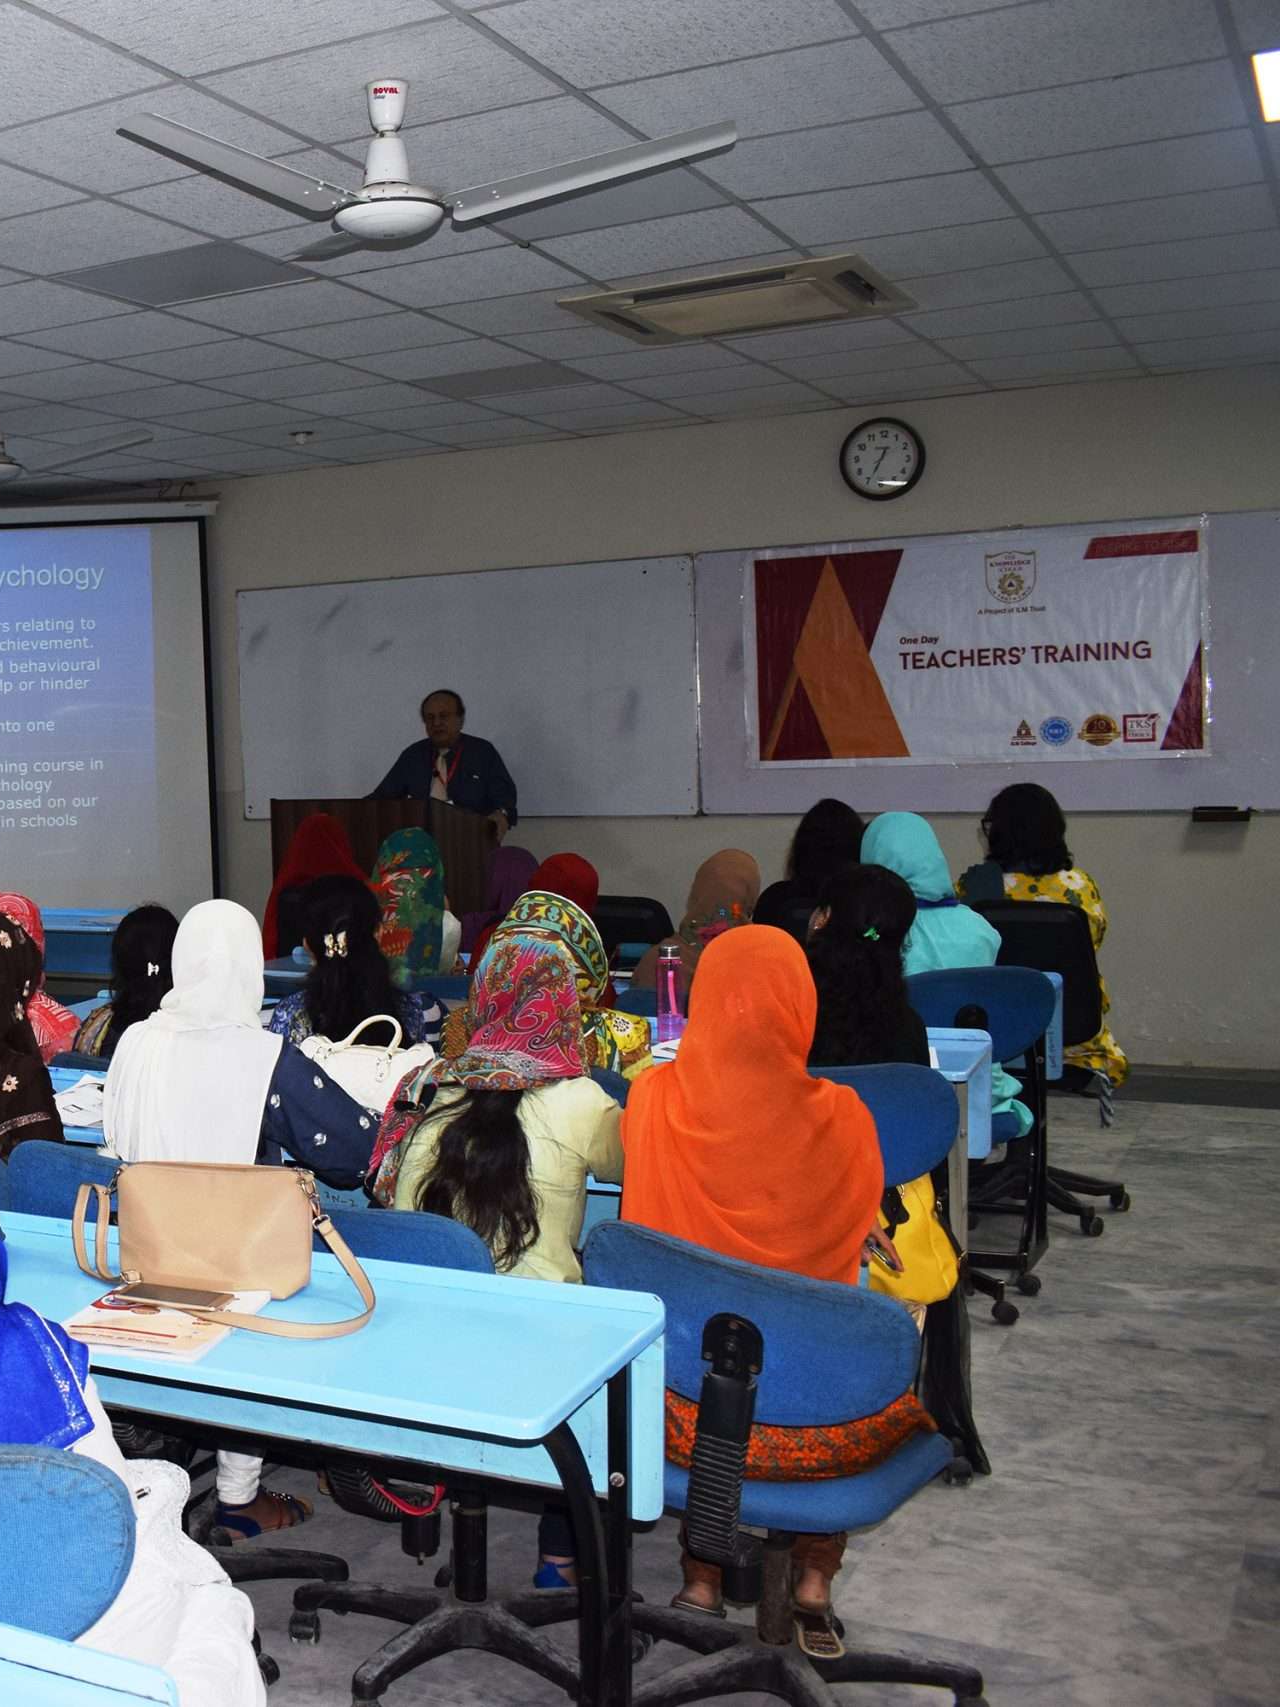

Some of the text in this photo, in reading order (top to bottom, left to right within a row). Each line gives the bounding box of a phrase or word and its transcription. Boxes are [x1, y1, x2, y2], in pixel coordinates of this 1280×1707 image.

[15, 617, 74, 633] relating
[80, 616, 96, 630] to
[899, 635, 939, 645] One Day
[899, 640, 1152, 670] TEACHERS' TRAINING
[8, 655, 100, 673] behavioural
[18, 680, 35, 691] or
[40, 675, 89, 690] hinder
[25, 719, 55, 731] one
[1128, 719, 1152, 728] TKS
[32, 759, 84, 772] course
[89, 756, 104, 770] in
[47, 796, 66, 808] on
[71, 795, 98, 807] our
[0, 815, 15, 828] in
[20, 811, 78, 827] schools
